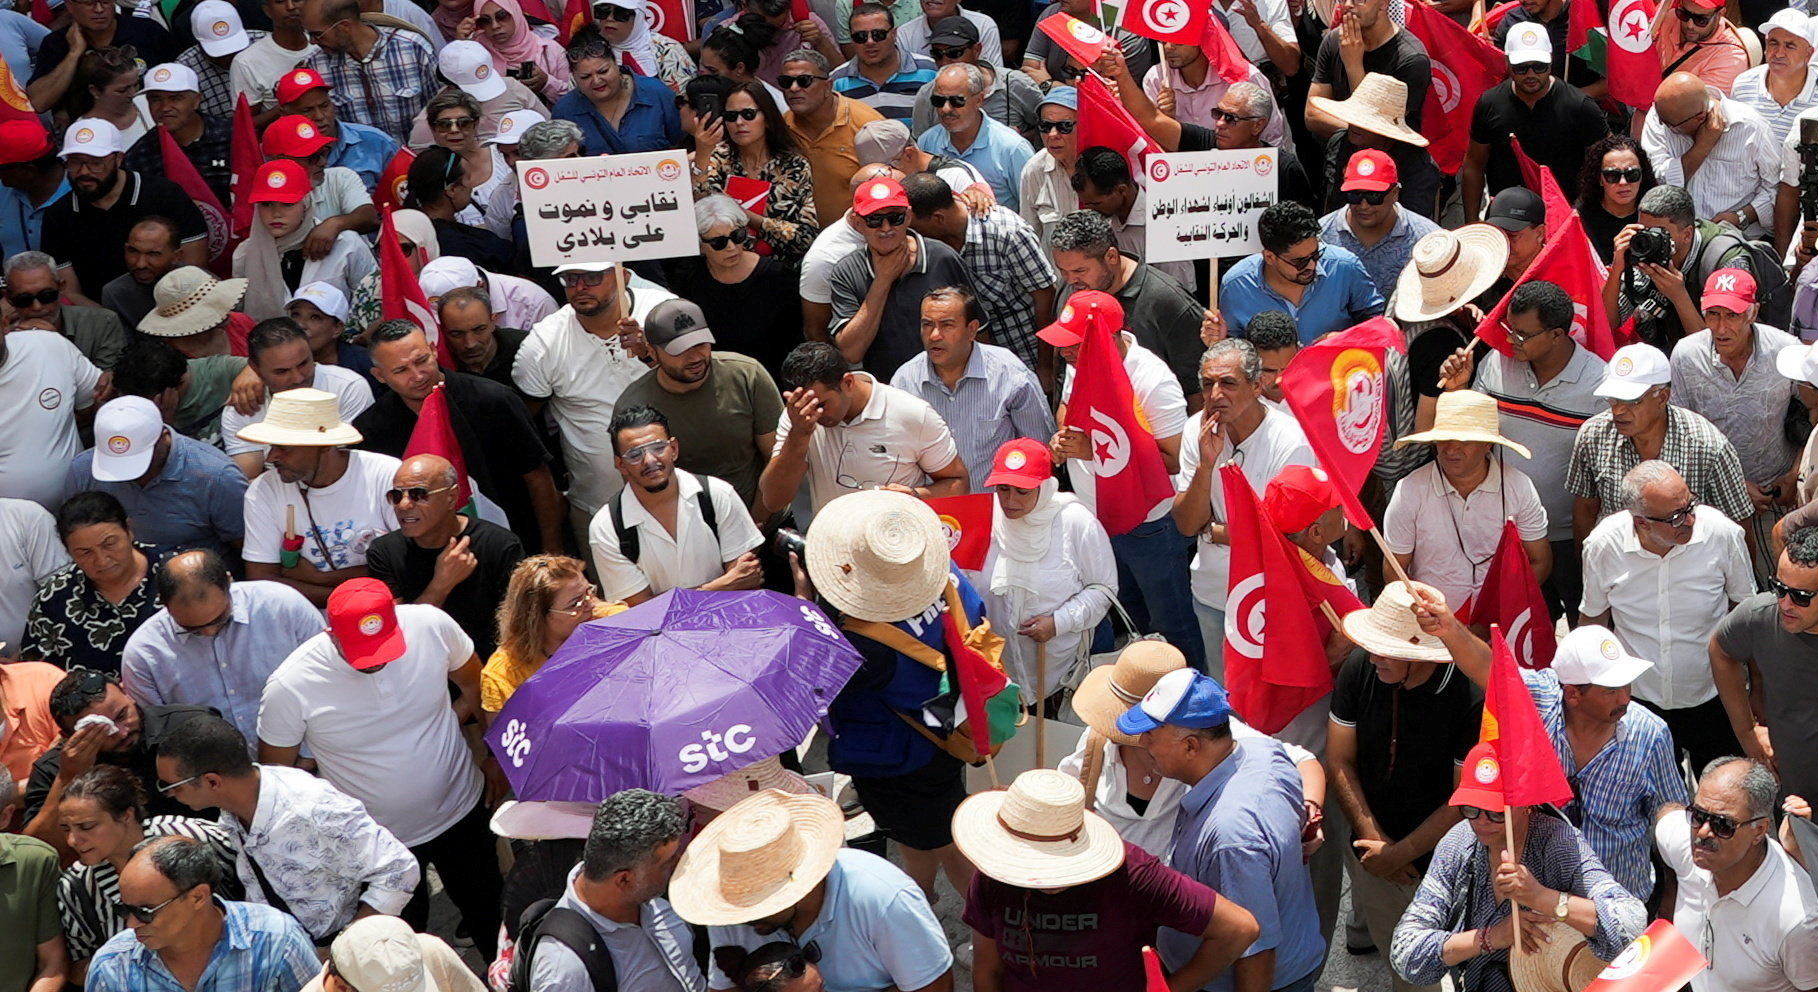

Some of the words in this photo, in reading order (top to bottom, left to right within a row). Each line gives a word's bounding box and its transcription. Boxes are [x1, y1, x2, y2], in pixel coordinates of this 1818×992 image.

[538, 199, 597, 224] نموت
[602, 200, 614, 221] و
[620, 190, 679, 224] نقابي
[1152, 197, 1179, 221] الوطن
[556, 226, 616, 258] بلادي
[622, 223, 666, 250] على
[1176, 224, 1211, 247] النقابية
[500, 718, 532, 768] stc
[677, 723, 757, 774] stc
[1004, 907, 1099, 931] UNDER
[1001, 953, 1098, 969] ARMOUR
